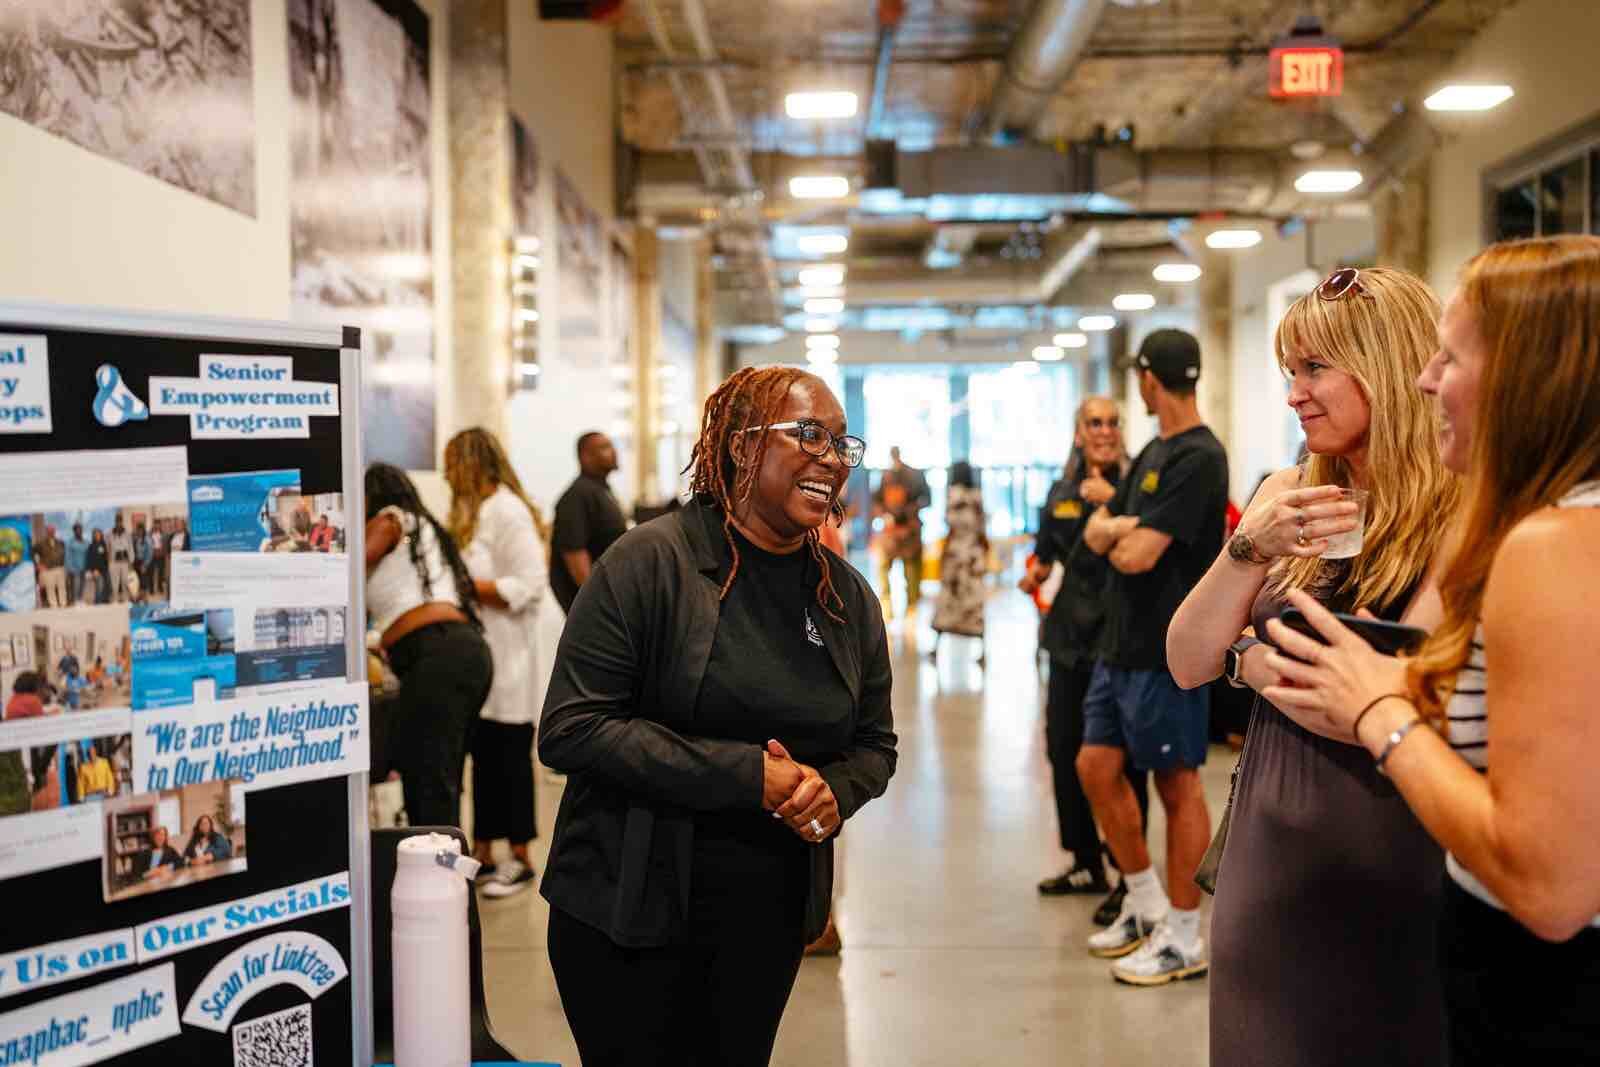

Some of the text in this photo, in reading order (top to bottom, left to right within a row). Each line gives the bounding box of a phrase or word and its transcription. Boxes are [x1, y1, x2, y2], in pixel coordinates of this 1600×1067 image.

[1282, 53, 1333, 93] EXIT
[207, 363, 287, 381] Senior
[160, 387, 332, 409] Empowerment
[196, 413, 304, 434] Program
[190, 721, 225, 749] are
[229, 711, 261, 744] the
[264, 699, 360, 742] Neighbors
[147, 762, 169, 793] to
[173, 755, 210, 788] Our
[15, 952, 70, 984] Us
[77, 942, 128, 969] on
[143, 915, 218, 953] Our
[223, 880, 349, 931] Socials
[200, 942, 336, 1021] Scan for Linktree
